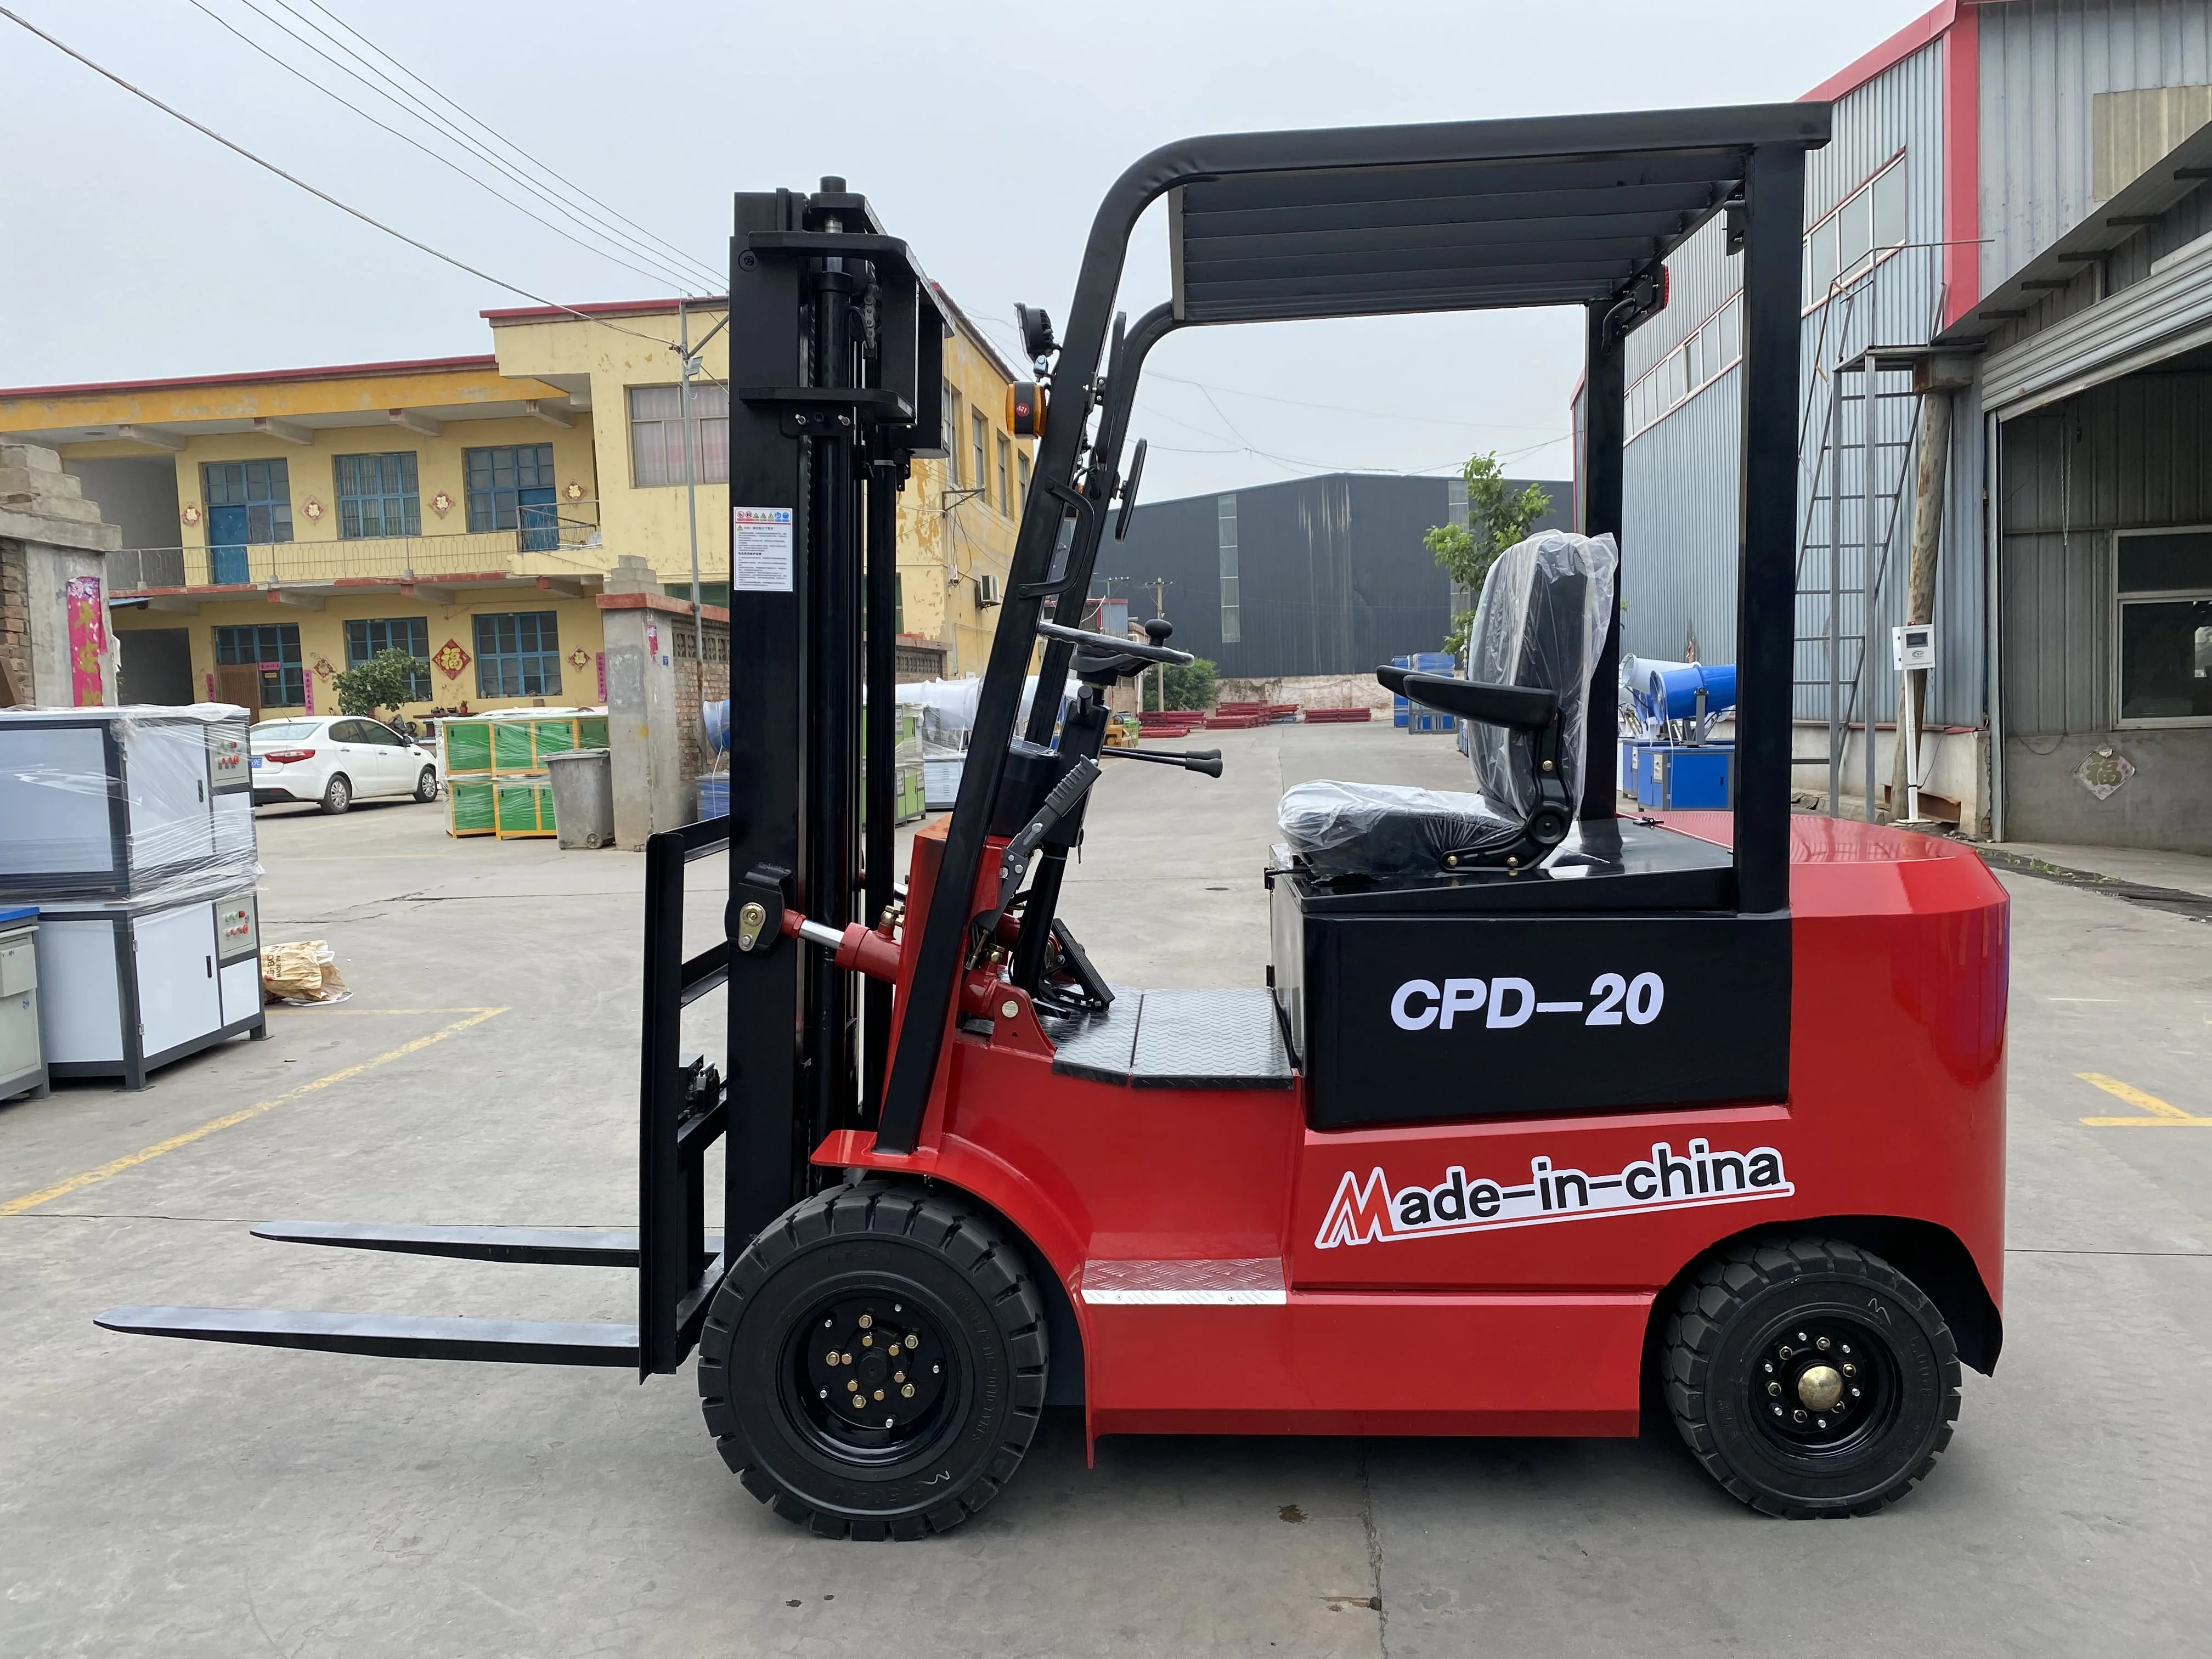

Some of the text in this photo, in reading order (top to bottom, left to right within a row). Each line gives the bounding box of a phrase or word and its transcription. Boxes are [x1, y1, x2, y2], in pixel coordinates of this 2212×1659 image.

[1017, 405, 1027, 413] 12V
[441, 646, 463, 670] 福
[2086, 751, 2122, 786] 福
[1390, 972, 1664, 1031] CPD-20
[1317, 1139, 1790, 1246] Made-in-china
